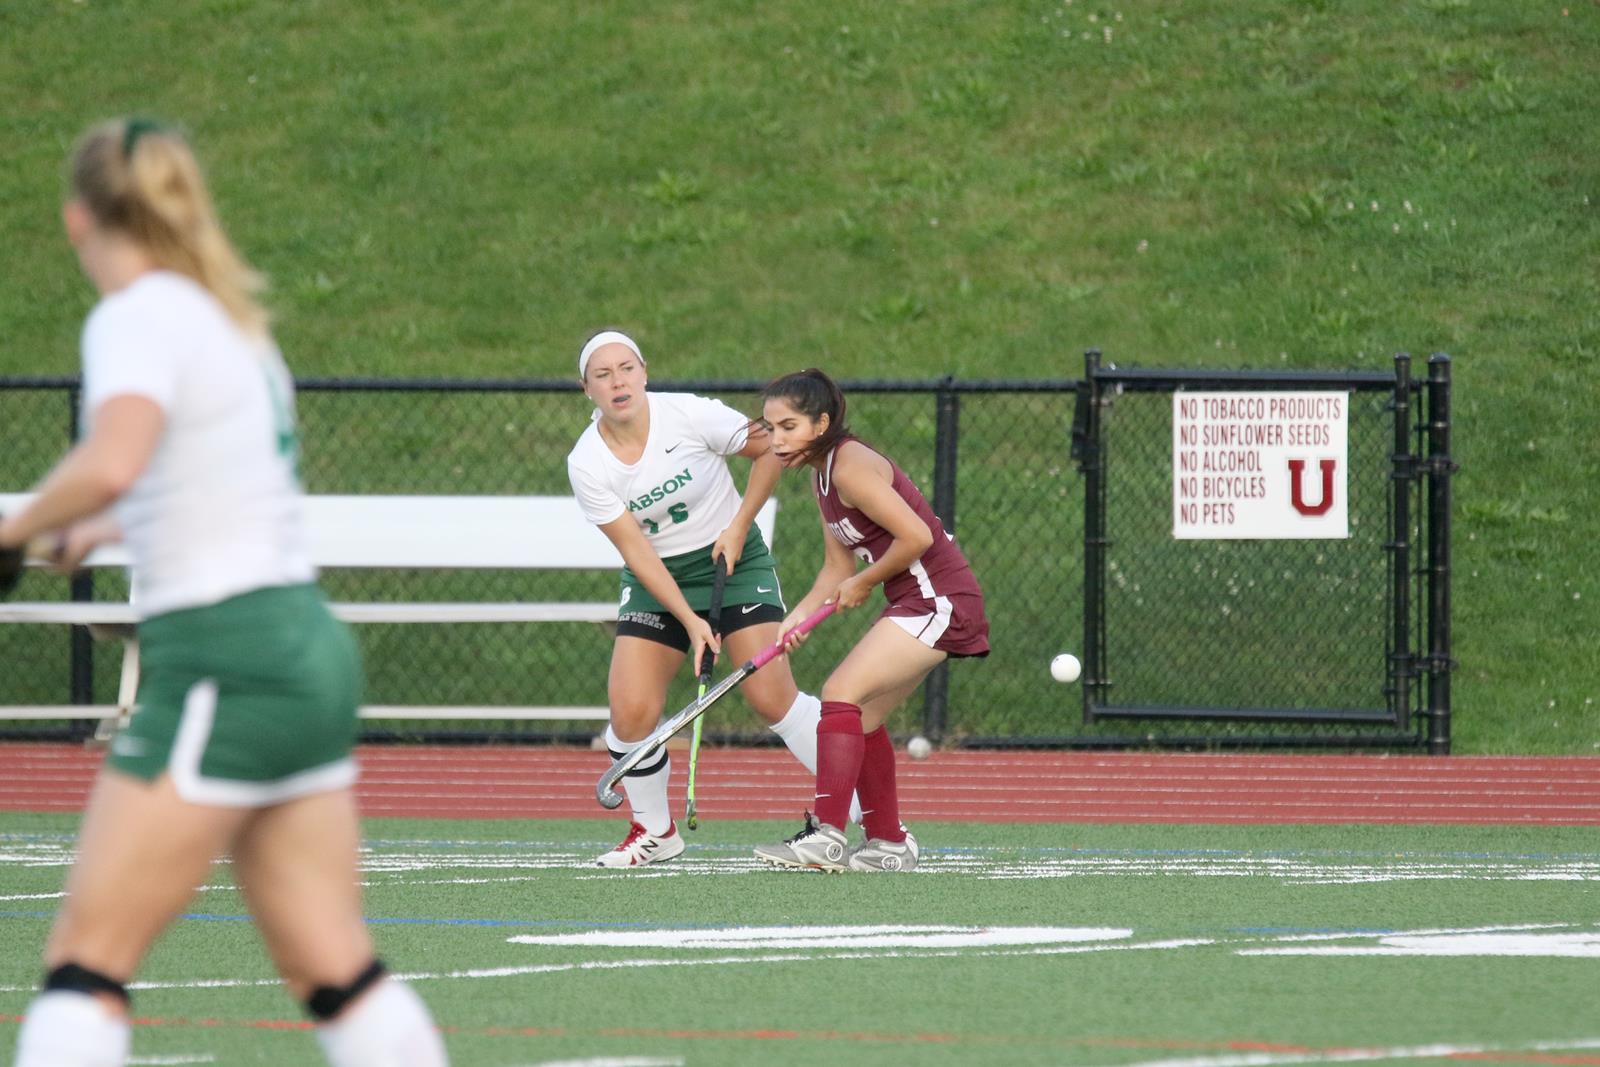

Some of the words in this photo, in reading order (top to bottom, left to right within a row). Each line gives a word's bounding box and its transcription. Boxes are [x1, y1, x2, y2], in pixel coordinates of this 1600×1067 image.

[1180, 399, 1198, 419] NO
[1203, 399, 1264, 419] TOBACCO
[1270, 398, 1341, 419] PRODUCTS
[1180, 425, 1198, 446] NO
[1203, 425, 1283, 446] SUNFLOWER
[1288, 425, 1330, 446] SEEDS
[1180, 451, 1198, 471] NO
[1203, 451, 1262, 471] ALCOHOL
[627, 468, 693, 512] ABSON
[1180, 477, 1198, 498] NO
[1203, 477, 1266, 498] BICYCLES
[1288, 459, 1336, 516] U
[1180, 503, 1198, 524] NO
[1203, 503, 1235, 524] PETS
